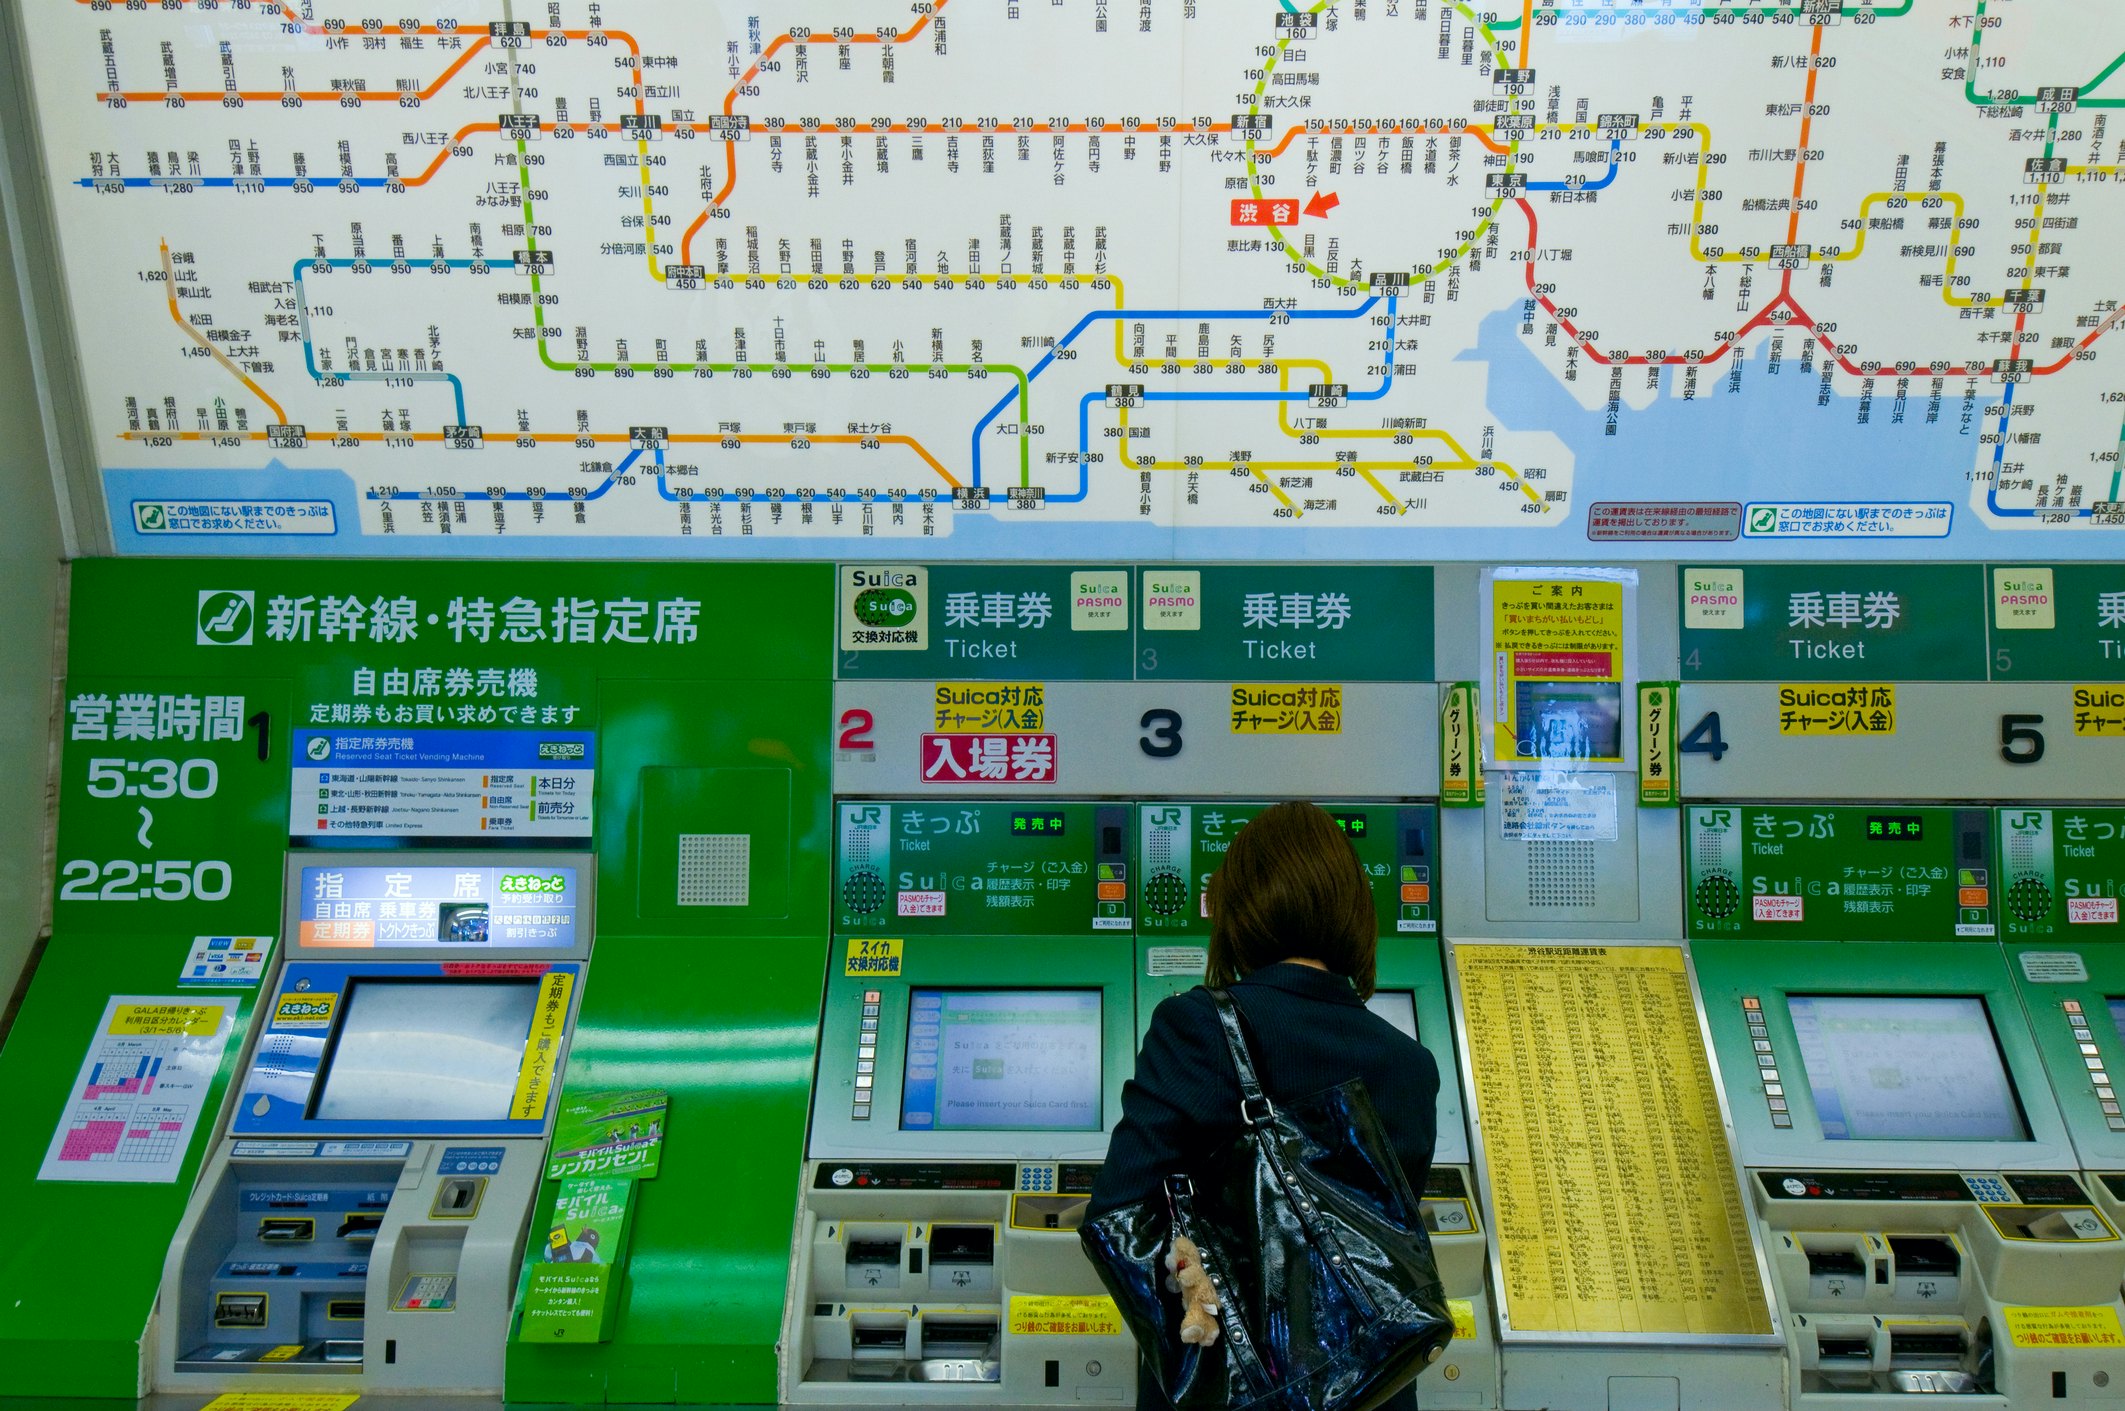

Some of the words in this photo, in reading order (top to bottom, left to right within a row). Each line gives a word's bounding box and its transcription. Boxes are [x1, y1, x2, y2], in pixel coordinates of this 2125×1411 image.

[1281, 14, 1312, 27] 池袋
[495, 23, 524, 36] 拝島
[1286, 28, 1306, 38] 160
[437, 38, 461, 50] 牛浜
[100, 29, 119, 91] 武蔵五日市
[220, 41, 237, 91] 武蔵引田
[642, 56, 677, 68] 東中神
[882, 45, 894, 83] 北朝霞
[1272, 73, 1319, 86] 高田馬場
[1498, 70, 1529, 83] 上野
[2043, 88, 2073, 101] 成田
[106, 99, 127, 109] 780
[1263, 96, 1311, 108] 新大久保
[2041, 102, 2071, 113] 1,280
[502, 115, 538, 128] 八王子
[628, 116, 655, 128] 立川
[711, 116, 747, 128] 西国分寺
[1237, 116, 1266, 128] 新宿
[1496, 116, 1534, 128] 秋葉原
[1599, 115, 1635, 128] 錦糸町
[510, 129, 532, 140] 690
[1242, 130, 1262, 140] 150
[947, 137, 959, 173] 吉祥寺
[1211, 150, 1245, 162] 代々木
[1447, 137, 1461, 186] 御茶ノ水
[386, 153, 399, 177] 高尾
[806, 137, 819, 198] 武蔵小金井
[2031, 159, 2063, 172] 佐倉
[1894, 155, 1908, 191] 津田沼
[1225, 177, 1248, 189] 原宿
[1491, 174, 1521, 187] 東京
[95, 183, 124, 194] 1,450
[1550, 191, 1597, 203] 新日本橋
[1239, 203, 1290, 223] 渋谷
[1868, 218, 1904, 230] 東船橋
[1227, 241, 1261, 252] 恵比寿
[1771, 245, 1808, 258] 西船橋
[519, 251, 548, 263] 橋本
[667, 266, 702, 278] 府中本町
[1375, 274, 1403, 286] 品川
[2010, 290, 2040, 302] 千葉
[1263, 298, 1297, 309] 西大井
[264, 315, 298, 326] 海老名
[206, 330, 252, 342] 相模金子
[773, 316, 785, 362] 十日市場
[1021, 336, 1055, 348] 新川崎
[1566, 346, 1578, 381] 新木場
[1999, 360, 2027, 372] 蘇我
[1111, 385, 1139, 397] 鶴見
[1314, 385, 1343, 396] 川崎
[1317, 397, 1338, 407] 290
[1606, 367, 1622, 435] 葛西臨海公園
[1858, 378, 1874, 424] 海浜幕張
[1959, 378, 1976, 434] 千葉みなと
[577, 410, 589, 433] 藤沢
[267, 425, 304, 437] 国府津
[634, 428, 663, 440] 大船
[1400, 471, 1444, 483] 武蔵白石
[957, 488, 985, 499] 横浜
[1009, 488, 1043, 499] 東神奈川
[167, 505, 329, 518] この地図にない駅までのきっぷは
[1780, 508, 1946, 520] この地図にない駅までのきっぷは
[852, 571, 917, 587] Suica
[1080, 584, 1118, 594] Suica
[1077, 598, 1122, 607] PASMO
[1691, 595, 1738, 605] PASMO
[945, 592, 1053, 629] 乗車券
[1242, 592, 1351, 630] 乗車券
[1788, 591, 1900, 629] 乗車券
[266, 595, 701, 644] 新幹線・特急指定席
[852, 631, 918, 644] 交換対応機
[945, 640, 1018, 658] Ticket
[1243, 640, 1316, 659] Ticket
[1789, 640, 1865, 659] Ticket
[352, 666, 539, 698] 自由席券売機
[936, 686, 1043, 706] Suica対応
[1780, 688, 1891, 708] Suica対応
[70, 694, 245, 742] 営業時間
[309, 704, 581, 725] 定期券もお買い求めできます
[839, 709, 874, 749] 2
[1140, 709, 1182, 757] 3
[248, 711, 272, 762] 1
[1650, 708, 1662, 776] グリーン券
[1680, 711, 1729, 761] 4
[2000, 714, 2045, 764] 5
[335, 737, 415, 751] 指定席券売機
[1450, 709, 1462, 777] グリーン券
[419, 753, 450, 762] Vending
[926, 738, 1053, 780] 入場券
[87, 758, 219, 799] 5:30
[538, 778, 575, 789] 本日分
[538, 802, 575, 814] 前売分
[850, 807, 881, 824] JR
[902, 810, 981, 834] きっぷ
[1014, 818, 1062, 830] 発売中
[1752, 814, 1835, 838] きっぷ
[1869, 821, 1920, 835] 発売中
[900, 839, 930, 851] Ticket
[849, 863, 881, 873] CHARGE
[60, 860, 232, 900] 22:50
[501, 877, 564, 892] えきねっと
[898, 872, 983, 890] Suica
[986, 878, 1071, 891] 履歴表示・印字
[1752, 876, 1840, 895] Suica
[986, 895, 1034, 907] 残額表示
[316, 902, 371, 918] 自由席
[379, 902, 436, 918] 乗車券
[314, 922, 371, 939] 定期券
[861, 941, 890, 955] スイカ
[848, 957, 899, 972] 交換対応機
[279, 1002, 329, 1015] えきねっと
[522, 974, 565, 1117] 定期券もご購入できます
[556, 1193, 608, 1210] モバイル
